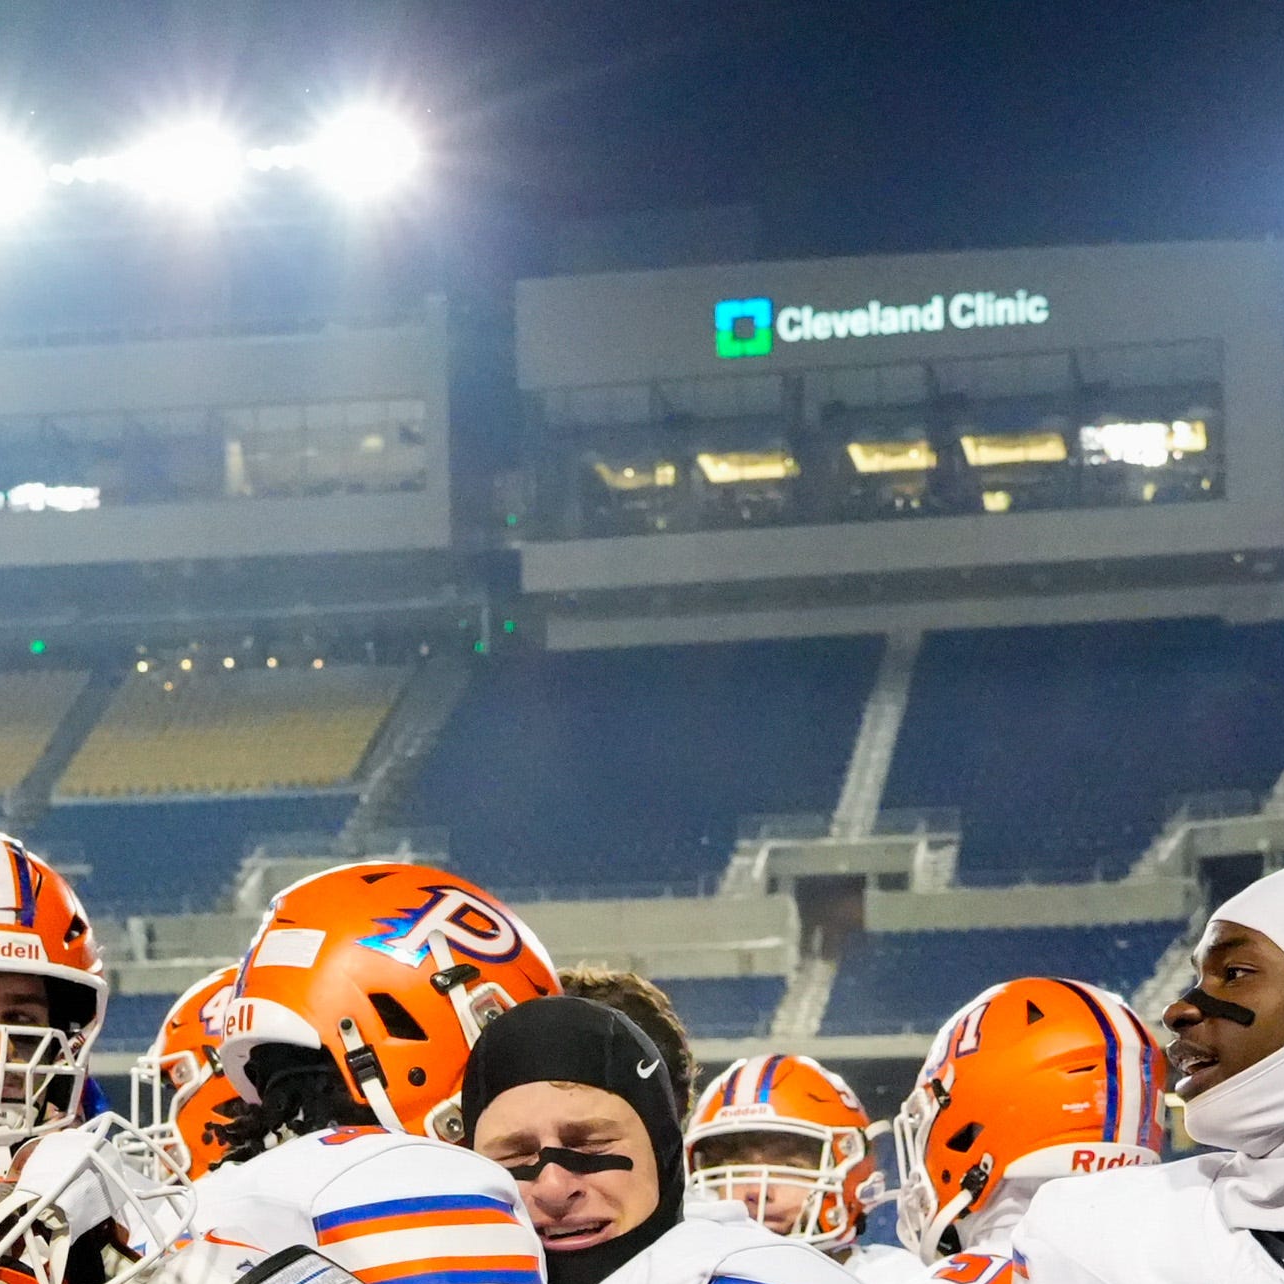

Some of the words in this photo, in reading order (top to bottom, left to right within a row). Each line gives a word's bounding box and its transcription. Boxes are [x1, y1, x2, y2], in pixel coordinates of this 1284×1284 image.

[776, 295, 945, 342] Cleveland
[948, 289, 1049, 329] Clinic
[354, 884, 523, 969] P
